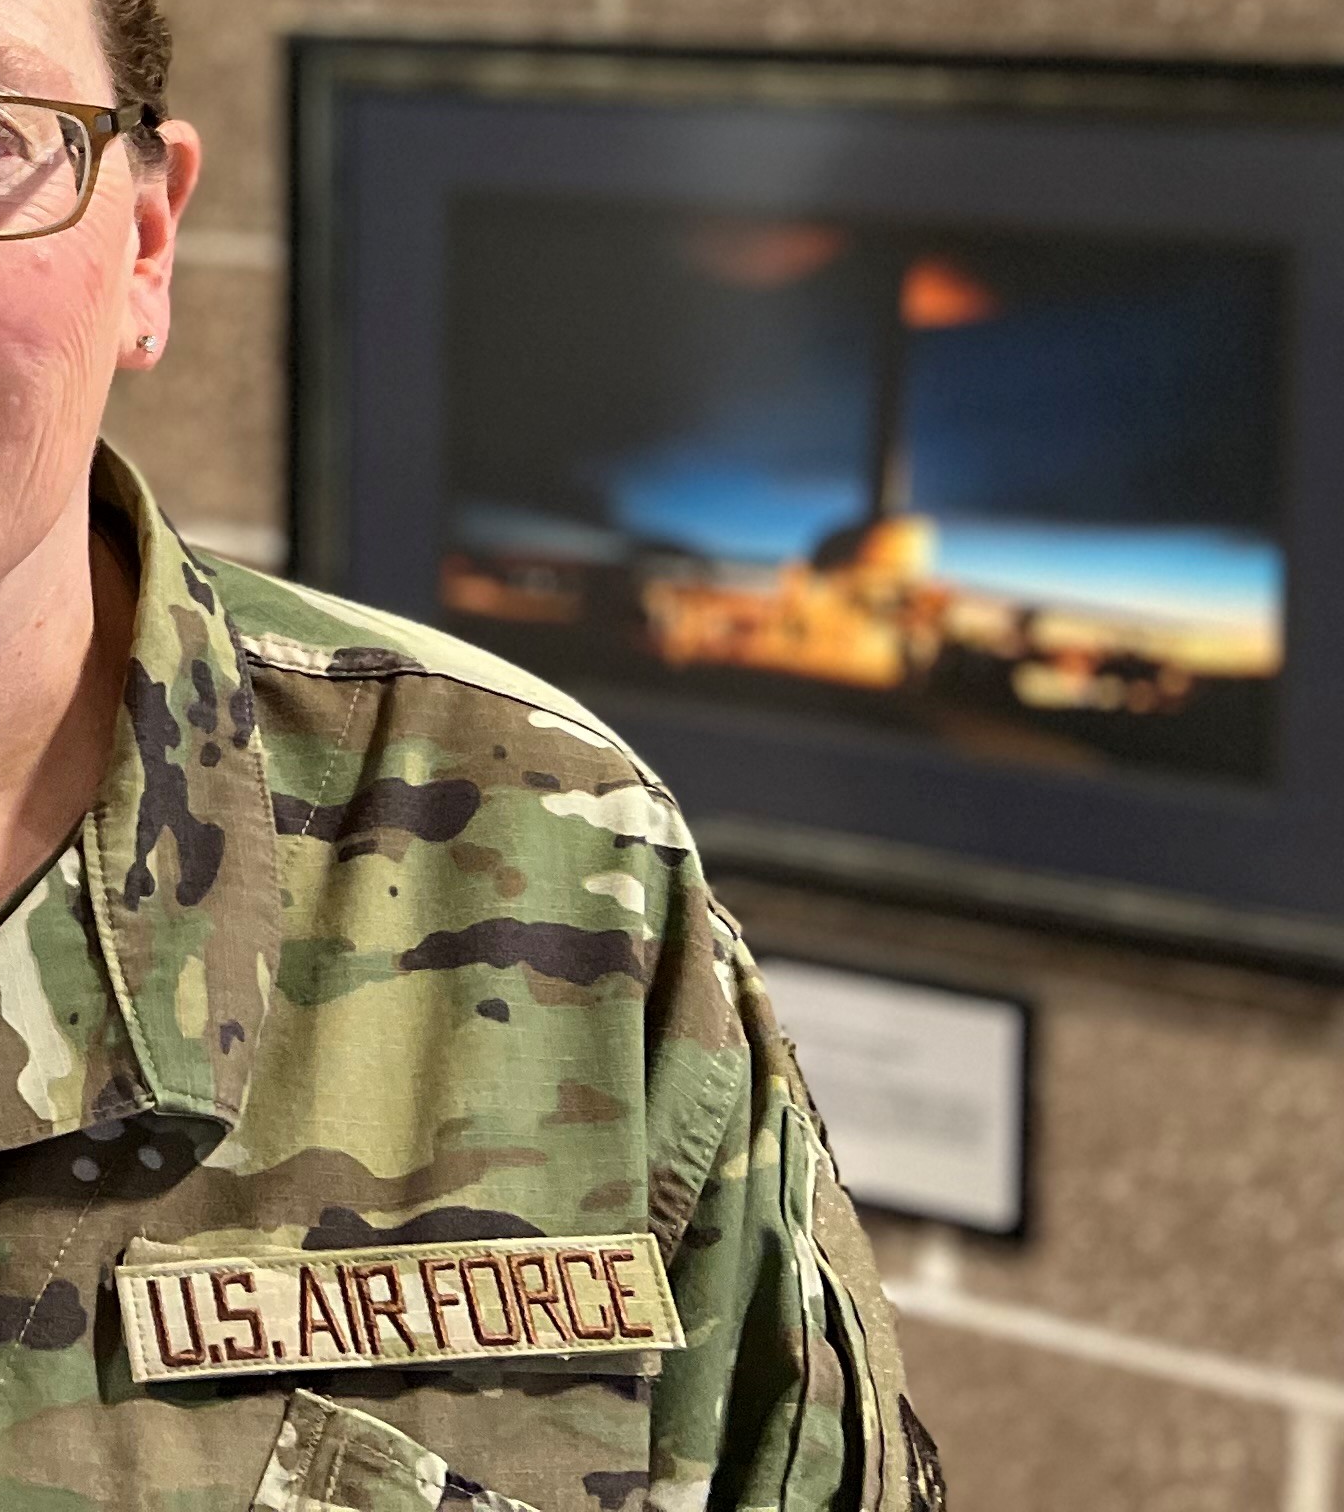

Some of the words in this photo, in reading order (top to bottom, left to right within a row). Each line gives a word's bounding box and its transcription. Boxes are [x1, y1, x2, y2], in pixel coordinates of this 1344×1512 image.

[146, 1271, 286, 1367] U.S.
[298, 1261, 416, 1356] AIR
[418, 1248, 655, 1350] FORCE
